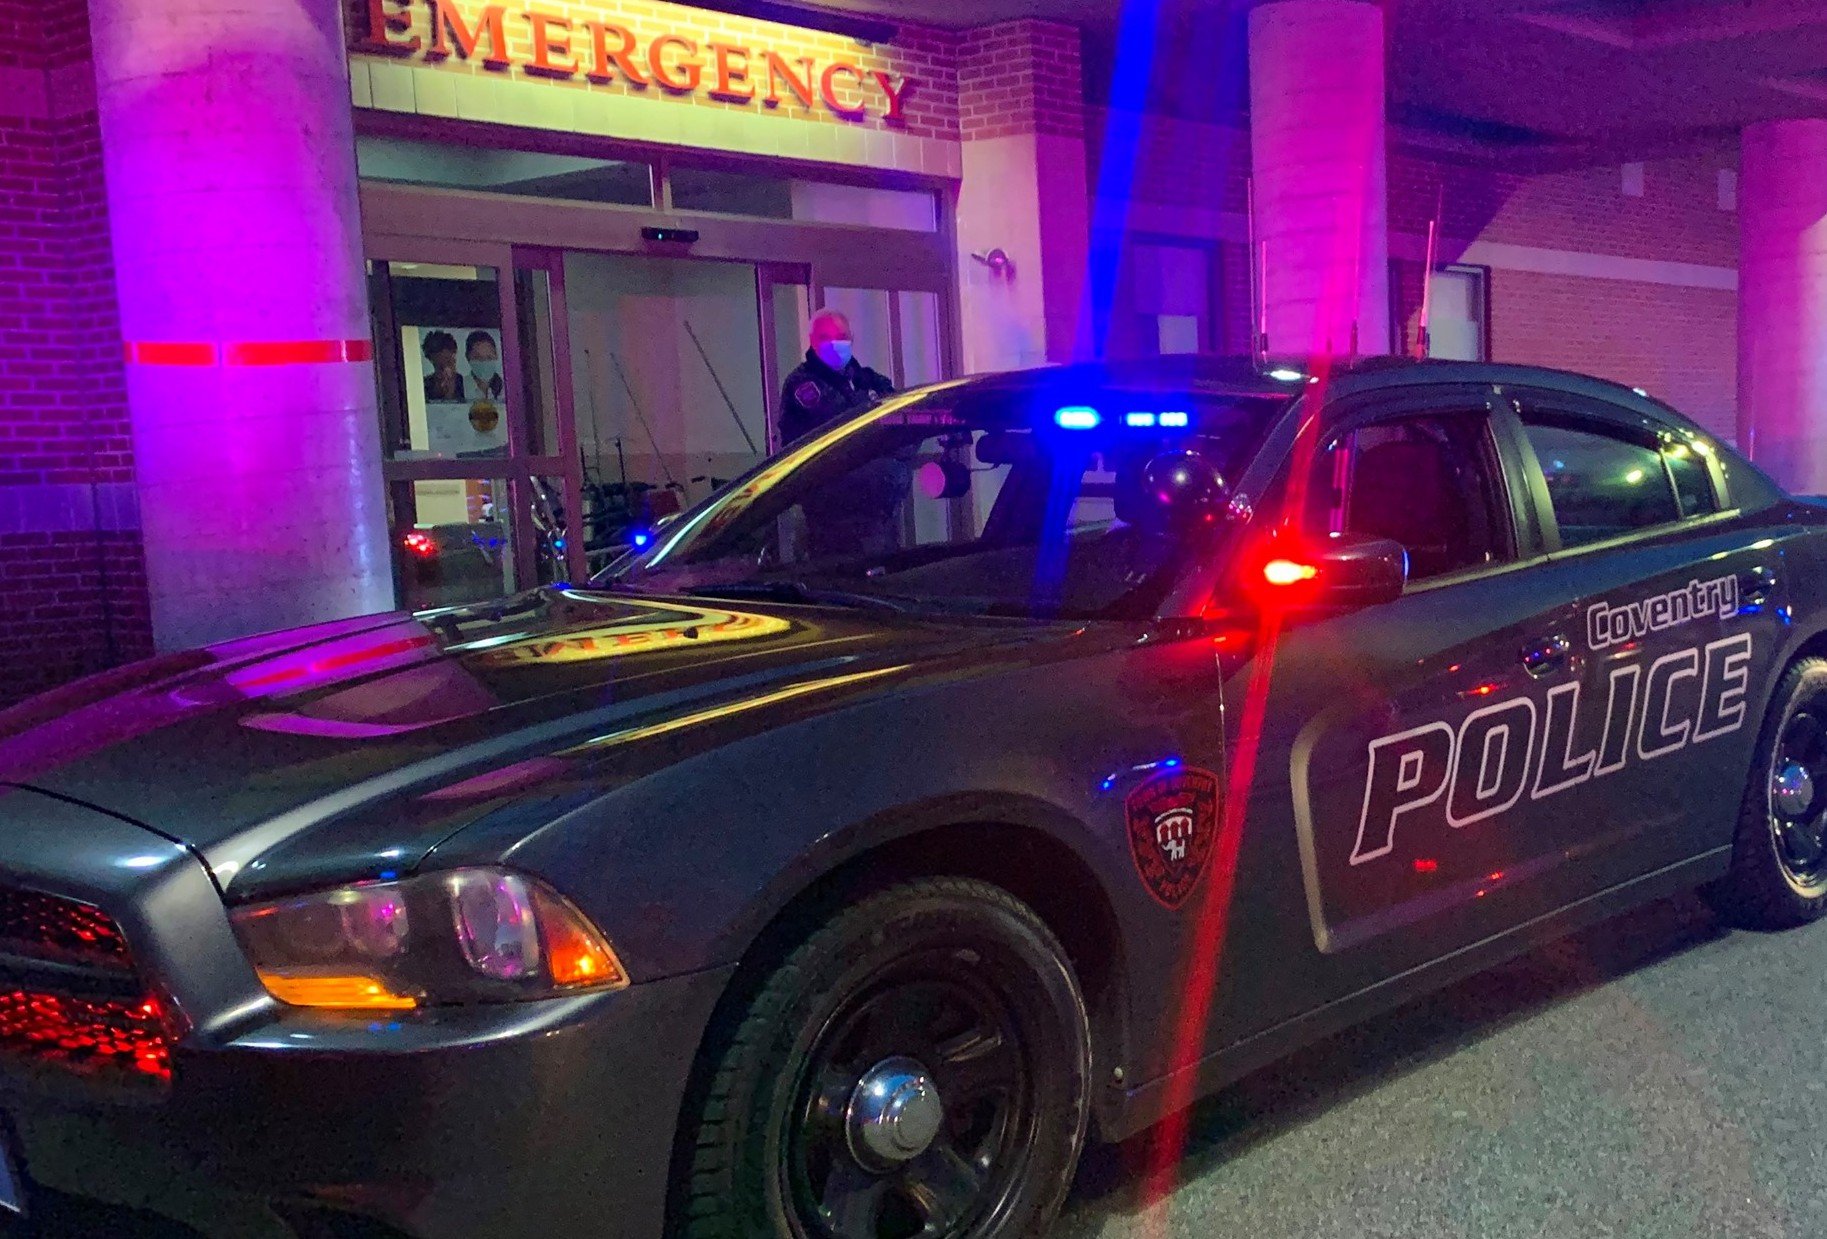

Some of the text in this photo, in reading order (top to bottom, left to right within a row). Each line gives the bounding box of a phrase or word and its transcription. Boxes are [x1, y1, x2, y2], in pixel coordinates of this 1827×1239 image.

[364, 0, 914, 120] EMERGENCY
[1587, 574, 1739, 650] Coventry
[1349, 632, 1752, 866] POLICE
